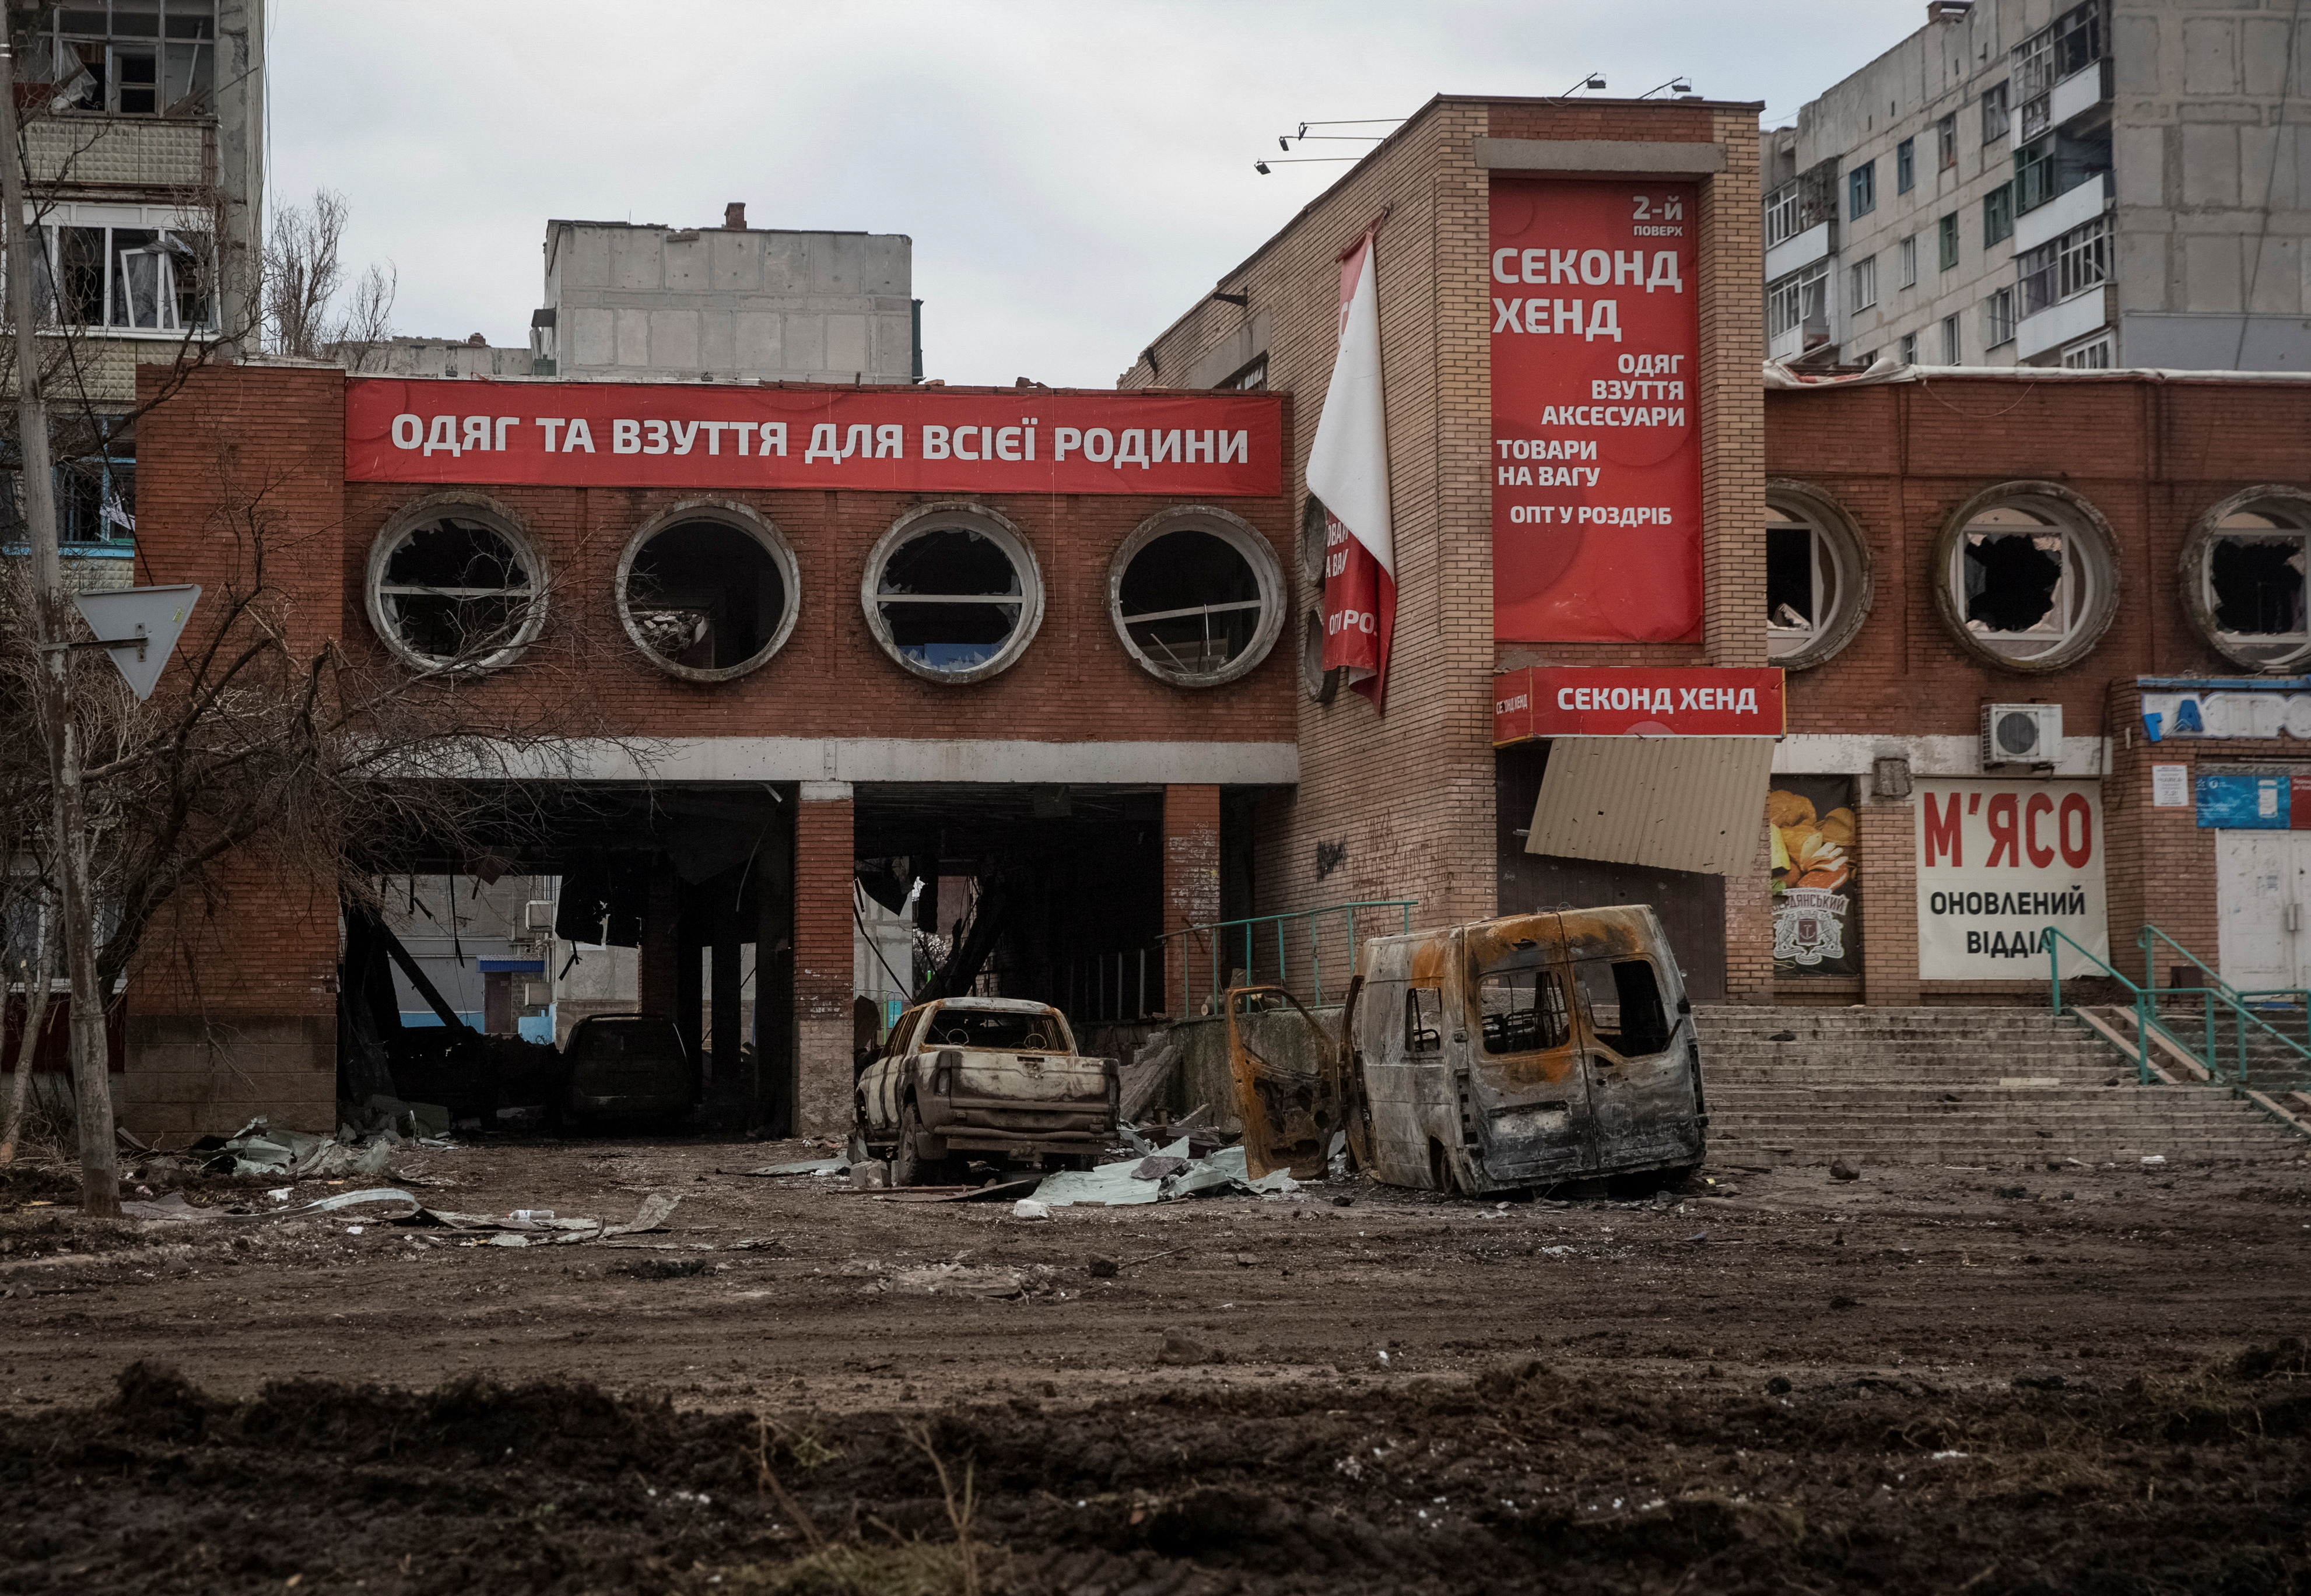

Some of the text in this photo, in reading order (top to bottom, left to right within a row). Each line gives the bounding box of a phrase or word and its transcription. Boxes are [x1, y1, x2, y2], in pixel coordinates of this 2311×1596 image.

[1633, 226, 1682, 237] ПОВЕРХ
[1492, 247, 1682, 293] СЕКОНД
[1492, 298, 1622, 342] ХЕНД
[1618, 353, 1684, 377] ОДЯГ
[1591, 380, 1684, 400] ВЗУТТЯ
[1541, 405, 1685, 426] АКСЕСУАРИ
[391, 413, 1248, 469] ОДЯГ ТА ВЗУТТЯ ДЛЯ ВСІЄЇ РОДИНИ
[1496, 439, 1597, 460] ТОВАРИ
[1498, 466, 1601, 487] НА ВАГУ
[1510, 506, 1672, 528] ОПТ У РОЗДРІБ
[1558, 687, 1758, 714] СЕКОНД ХЕНД
[1924, 792, 2092, 869] М'ЯСО
[1773, 894, 1845, 911] ДЯНСЬКИЙ
[1930, 885, 2086, 915] ОНОВЛЕНИЙ
